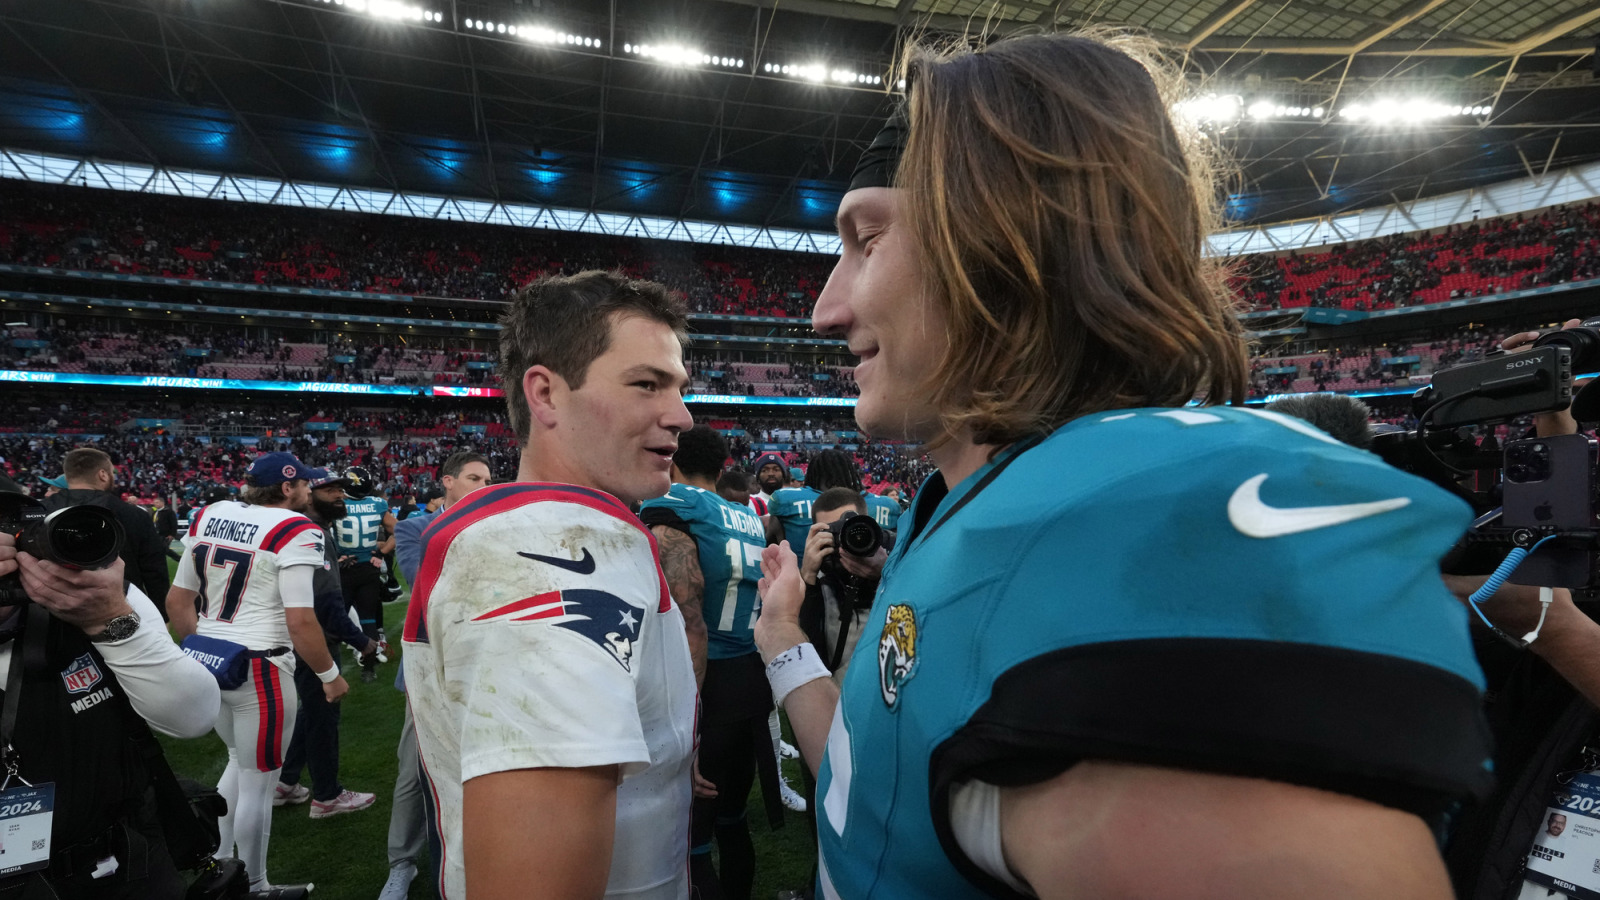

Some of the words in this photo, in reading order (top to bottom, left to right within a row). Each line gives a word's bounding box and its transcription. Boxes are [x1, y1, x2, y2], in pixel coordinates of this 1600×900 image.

[1506, 356, 1544, 370] SONY
[31, 373, 55, 381] WIN!
[142, 376, 200, 388] JAGUARS
[202, 379, 222, 388] WIN!
[299, 382, 349, 392] JAGUARS
[691, 394, 730, 404] JAGUARS
[808, 397, 843, 406] JAGUARS
[345, 503, 377, 514] TRANGE
[720, 504, 765, 539] ENGRAM
[203, 517, 259, 545] BARINGER
[336, 514, 382, 548] 85
[192, 541, 256, 624] 17
[183, 647, 225, 670] PATRIOTS
[65, 667, 99, 690] NFL
[70, 687, 114, 714] MEDIA
[0, 800, 42, 817] 2024
[0, 866, 22, 874] MEDIA
[1553, 879, 1576, 892] MEDIA
